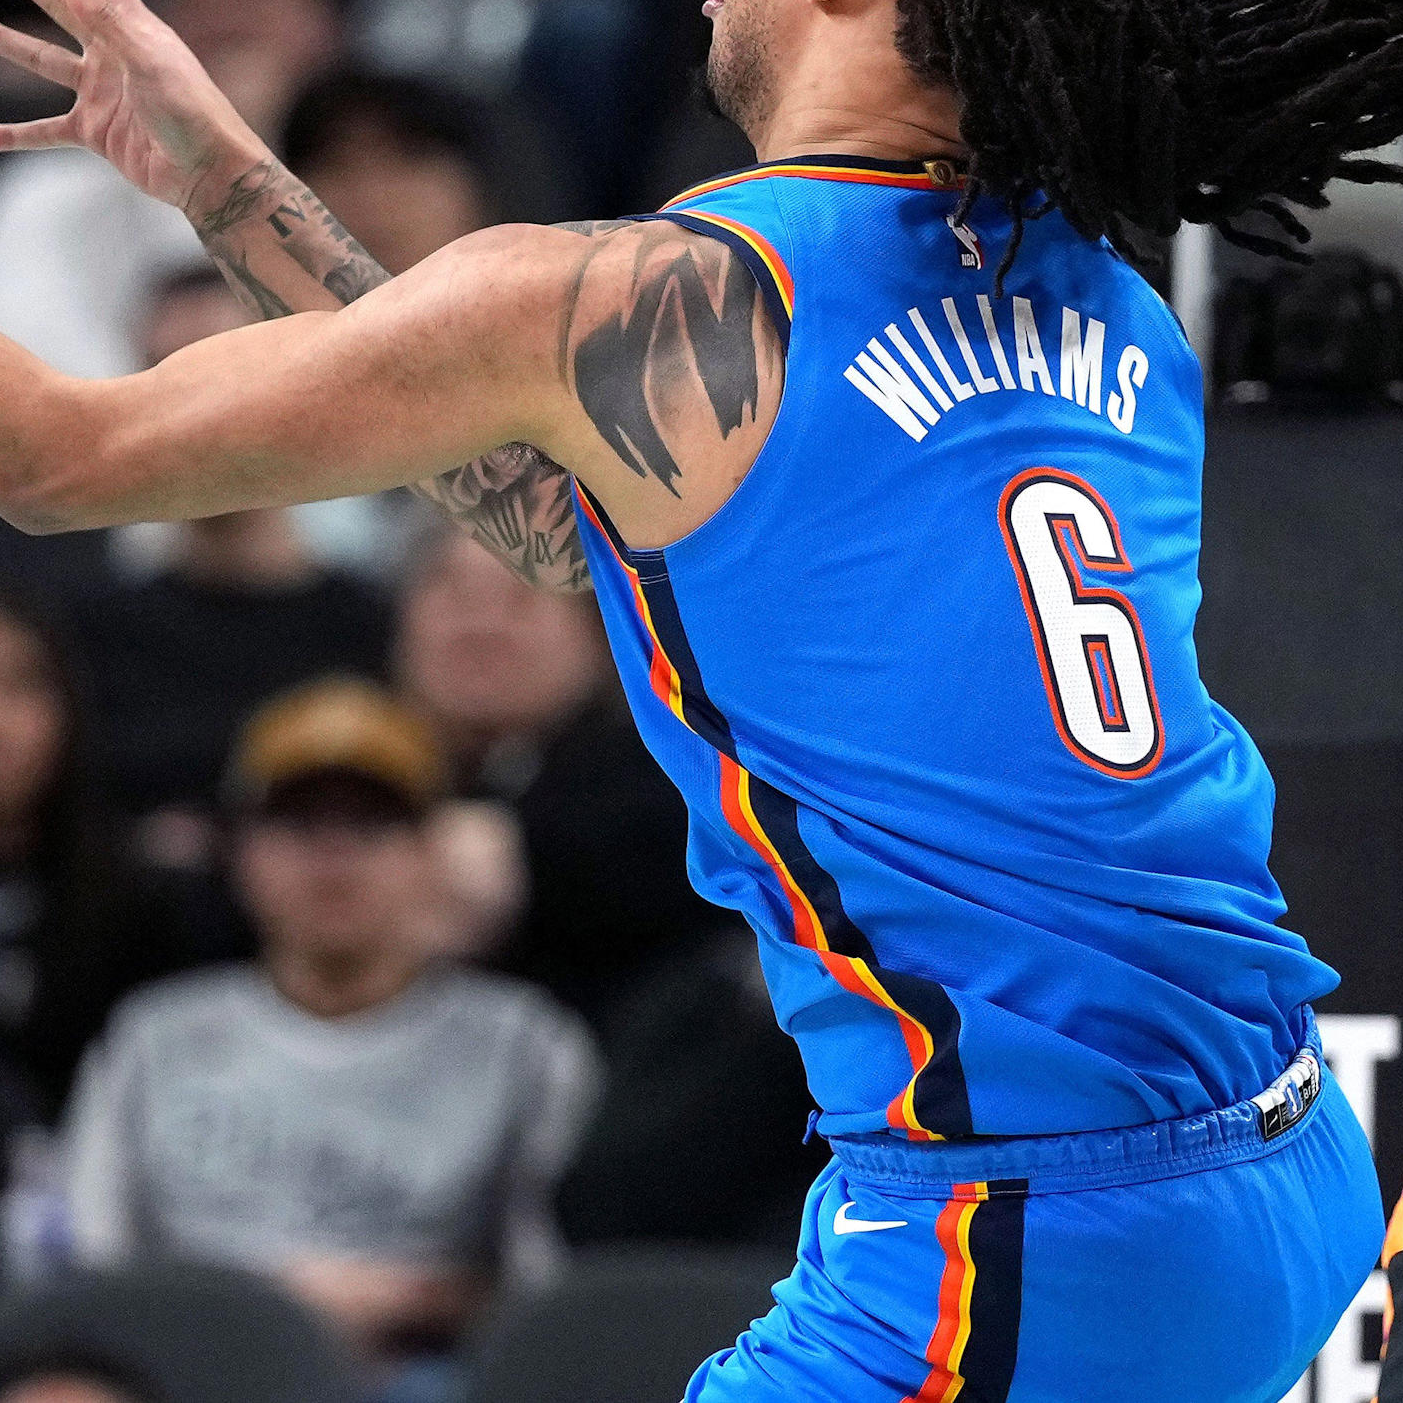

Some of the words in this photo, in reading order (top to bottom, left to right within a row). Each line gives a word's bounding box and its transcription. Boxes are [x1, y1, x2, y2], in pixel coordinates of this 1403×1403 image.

[961, 253, 976, 266] NBA
[843, 294, 1149, 443] WILLIAMS
[997, 466, 1166, 780] 6
